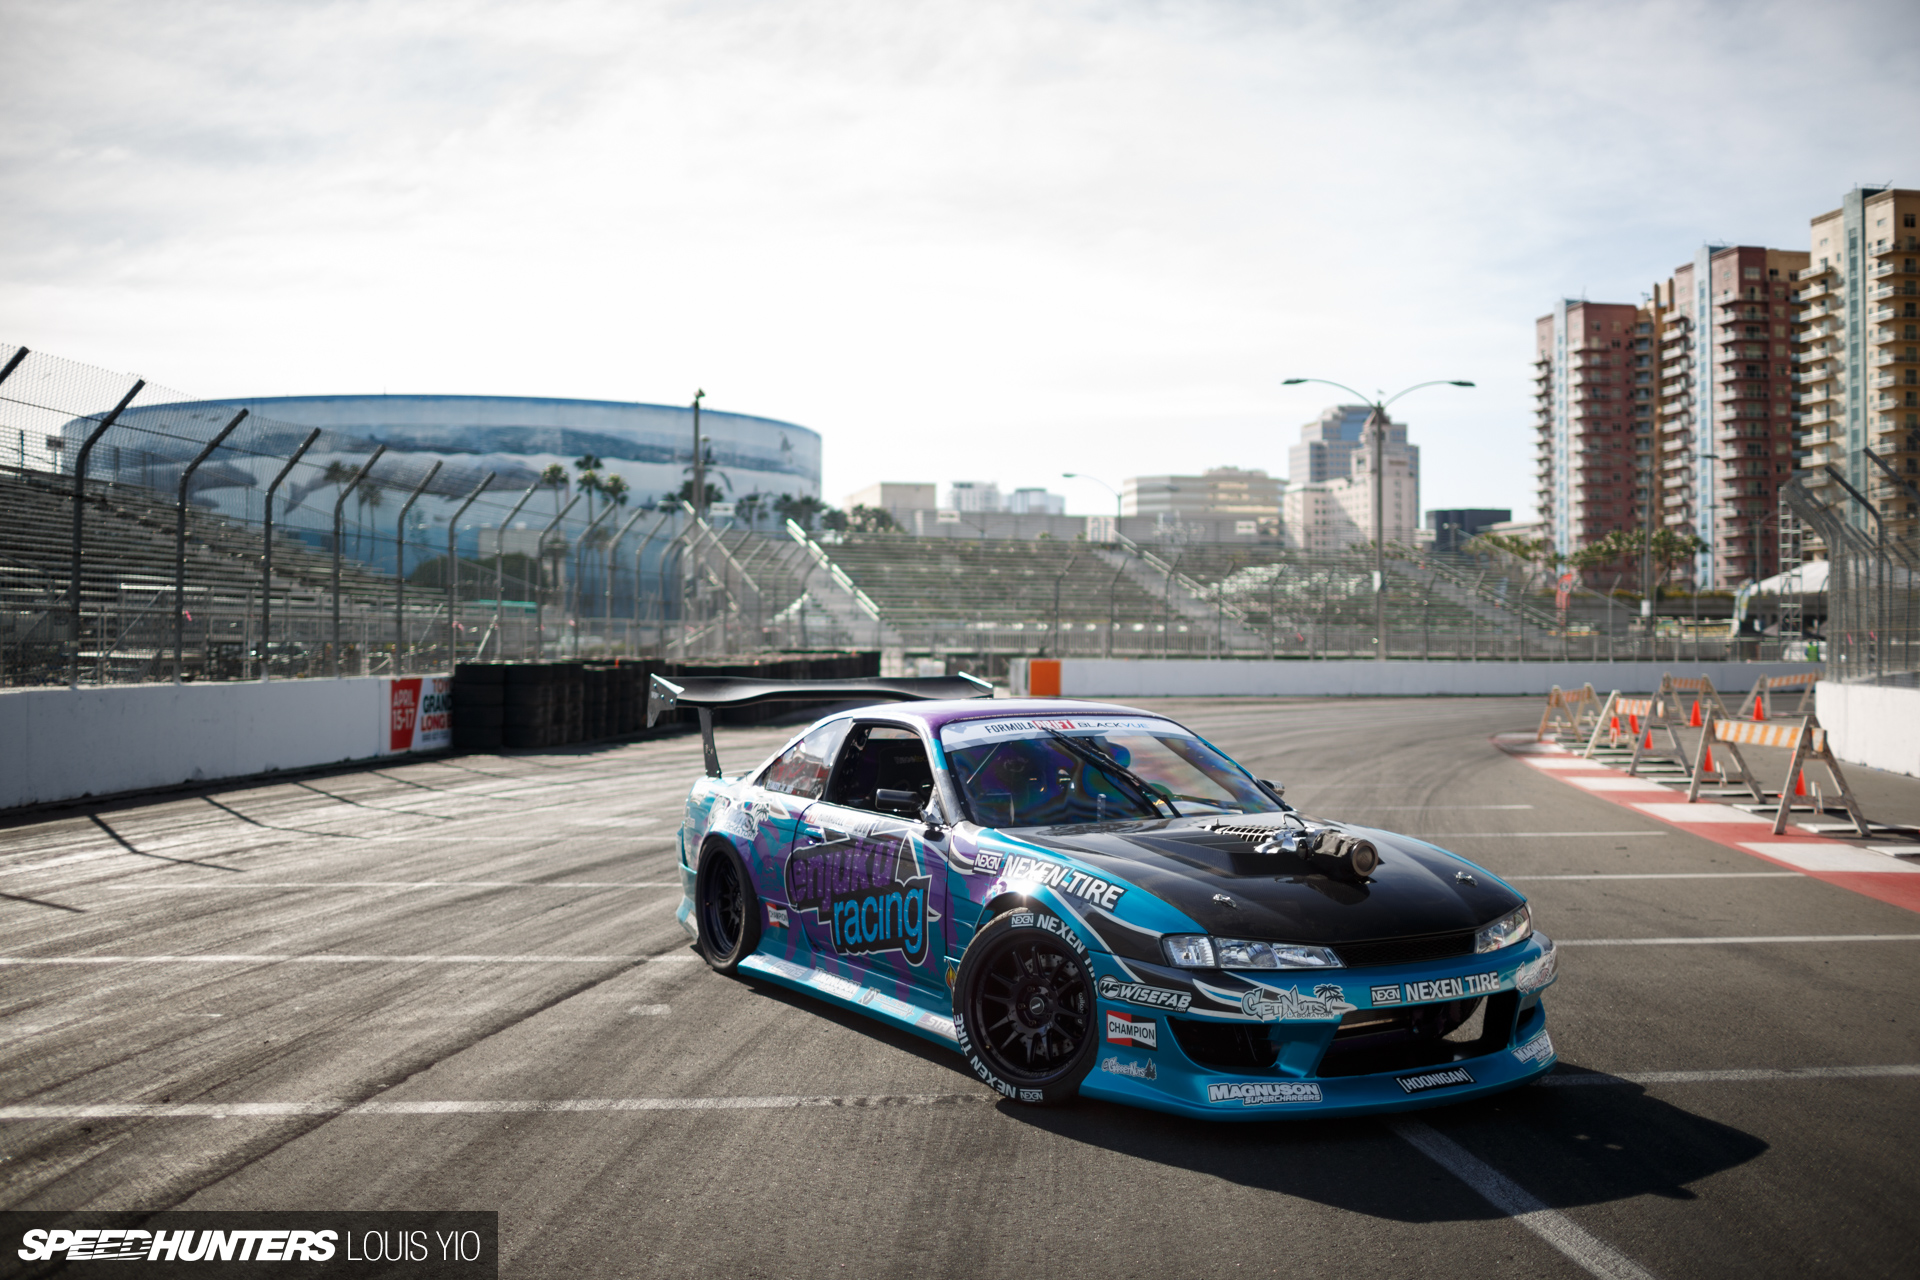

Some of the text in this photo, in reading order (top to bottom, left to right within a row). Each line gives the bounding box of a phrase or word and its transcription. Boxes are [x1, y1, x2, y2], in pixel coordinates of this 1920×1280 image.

[393, 689, 415, 707] APRIL
[392, 708, 415, 731] 15-17
[985, 720, 1074, 734] FORMULA DRIFT
[1077, 721, 1150, 729] BLACKVUE
[1001, 854, 1125, 910] NEXEN TIRE
[768, 909, 788, 922] CHAMPION
[833, 887, 924, 954] racing
[1036, 913, 1086, 955] NEXEN
[1120, 984, 1192, 1008] WISEFAB
[1405, 977, 1464, 1001] NEXEN
[1464, 972, 1500, 994] TIRE
[953, 1012, 970, 1057] TIRE
[1108, 1021, 1155, 1040] CHAMPION
[970, 1055, 1017, 1099] NEXEN
[1209, 1084, 1320, 1101] MAGNUSON
[1245, 1094, 1321, 1104] SUPERCHARGERS
